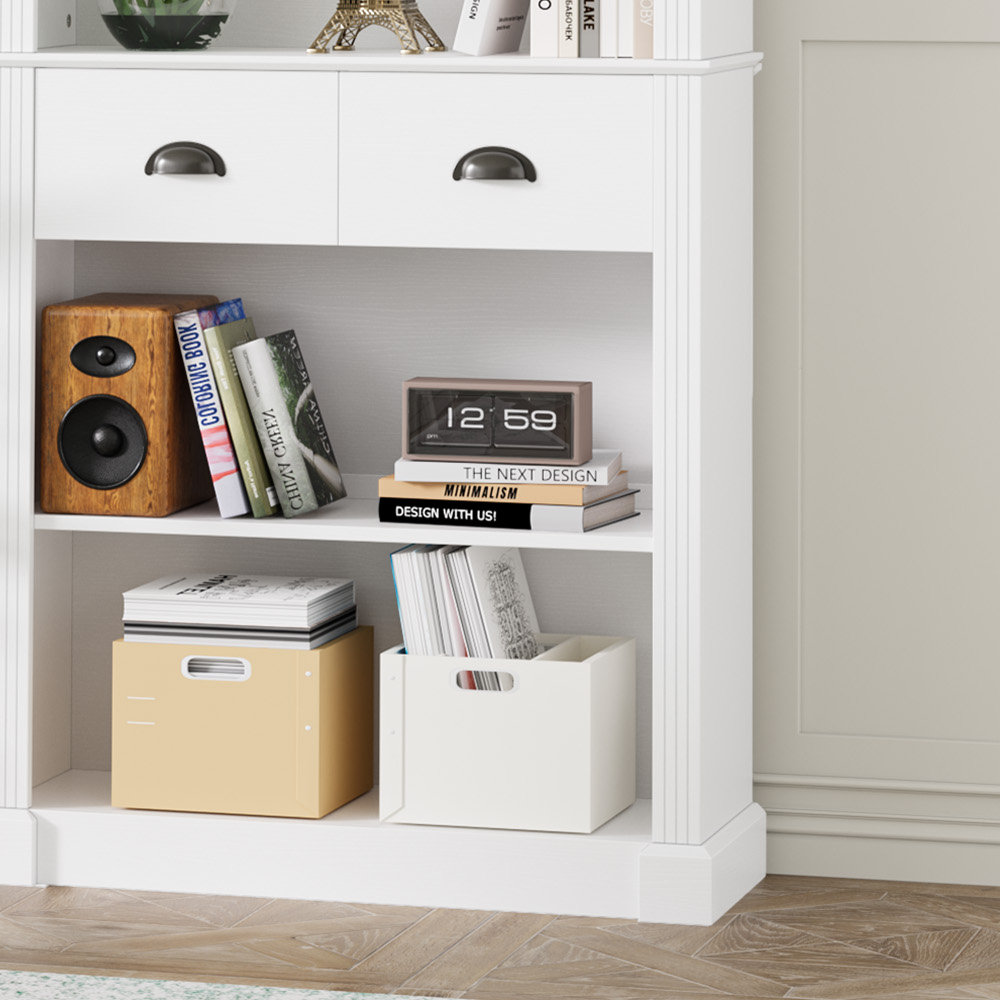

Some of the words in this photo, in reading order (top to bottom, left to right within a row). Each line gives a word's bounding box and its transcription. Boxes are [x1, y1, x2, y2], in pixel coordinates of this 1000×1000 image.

[565, 0, 573, 41] БАБОЧЕК
[447, 407, 484, 429] 12
[503, 409, 557, 431] 59
[463, 467, 491, 480] THE
[497, 467, 536, 481] NEXT
[542, 469, 598, 482] DESIGN
[444, 484, 518, 500] MINIMALISM
[395, 506, 439, 519] DESIGN
[443, 508, 473, 520] WITH
[477, 509, 497, 521] US!
